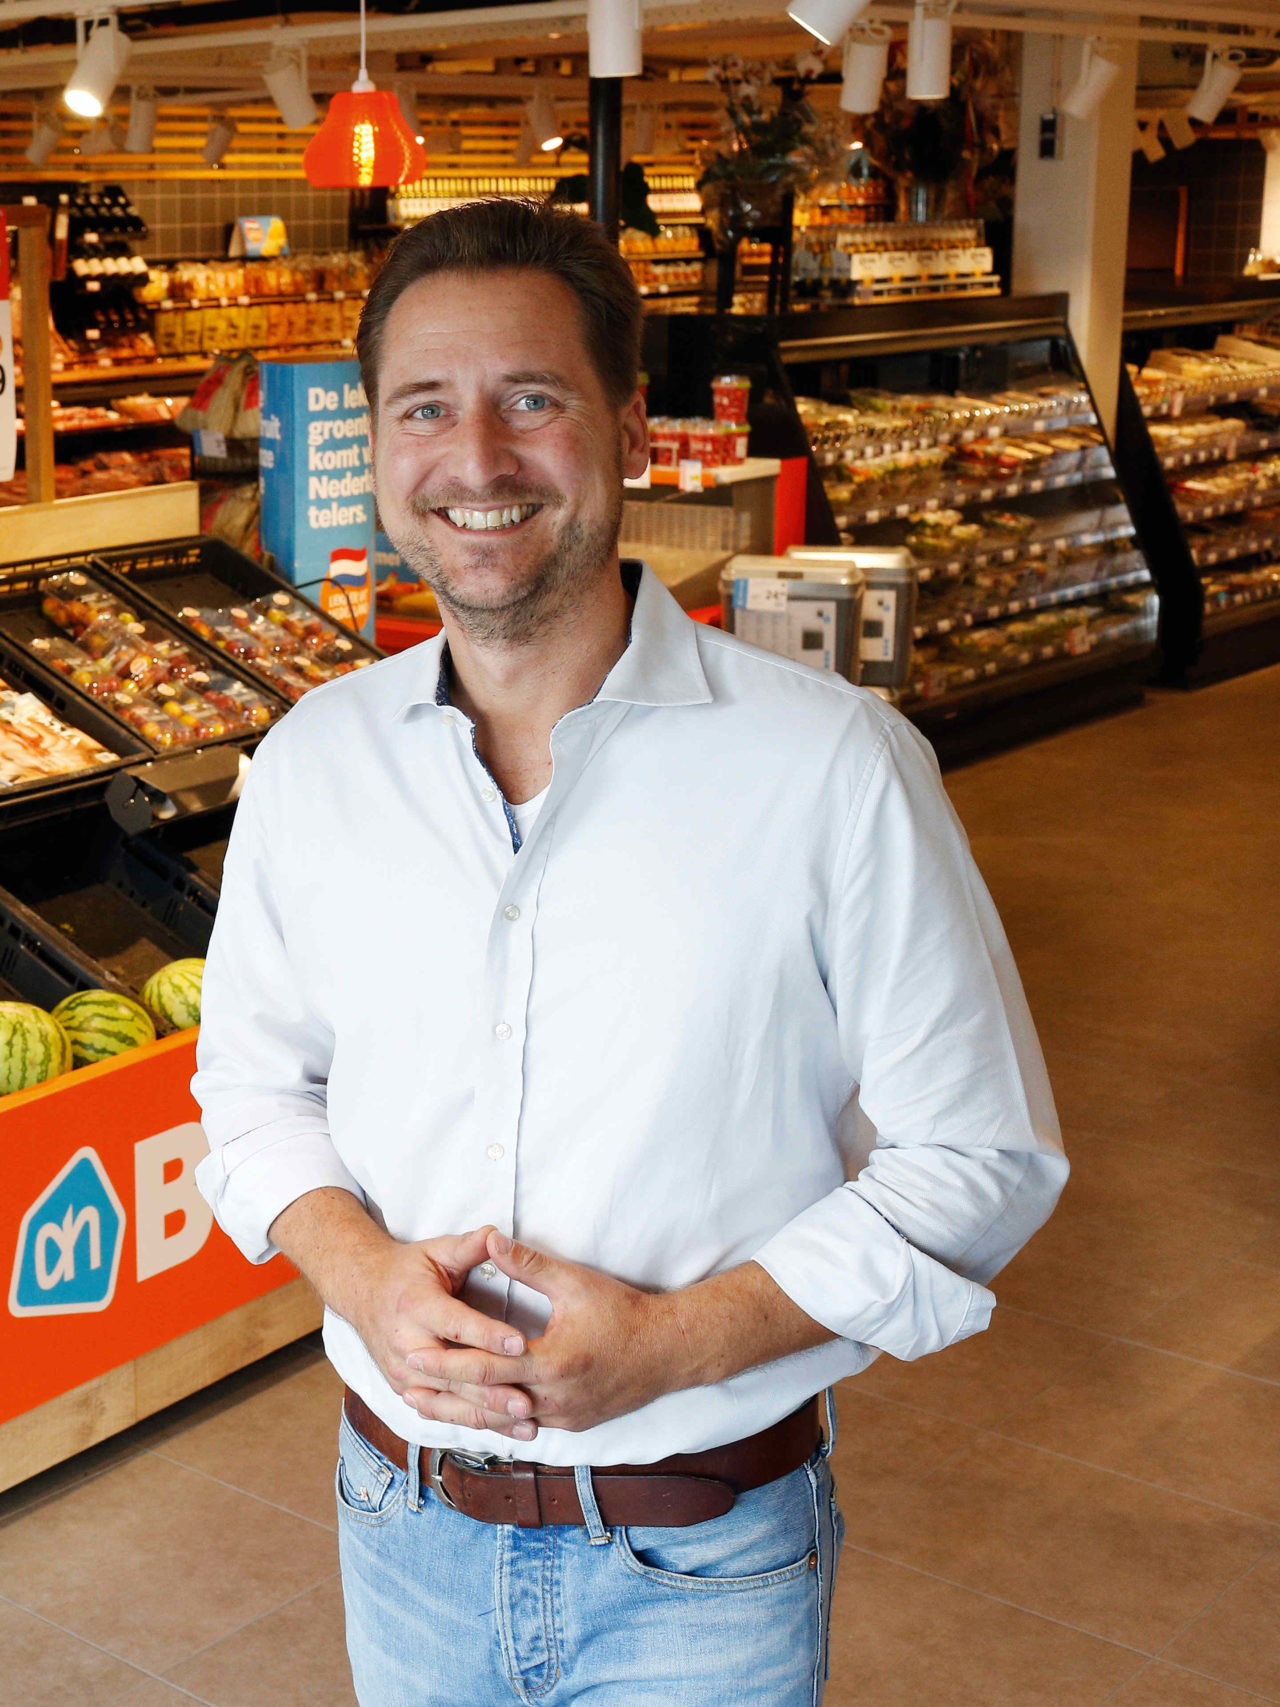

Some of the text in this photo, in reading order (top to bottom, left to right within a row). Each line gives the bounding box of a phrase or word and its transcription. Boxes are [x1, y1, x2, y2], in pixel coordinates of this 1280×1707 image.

[308, 387, 338, 411] De
[308, 444, 360, 471] komt
[308, 502, 368, 529] telers.
[134, 1121, 214, 1283] B
